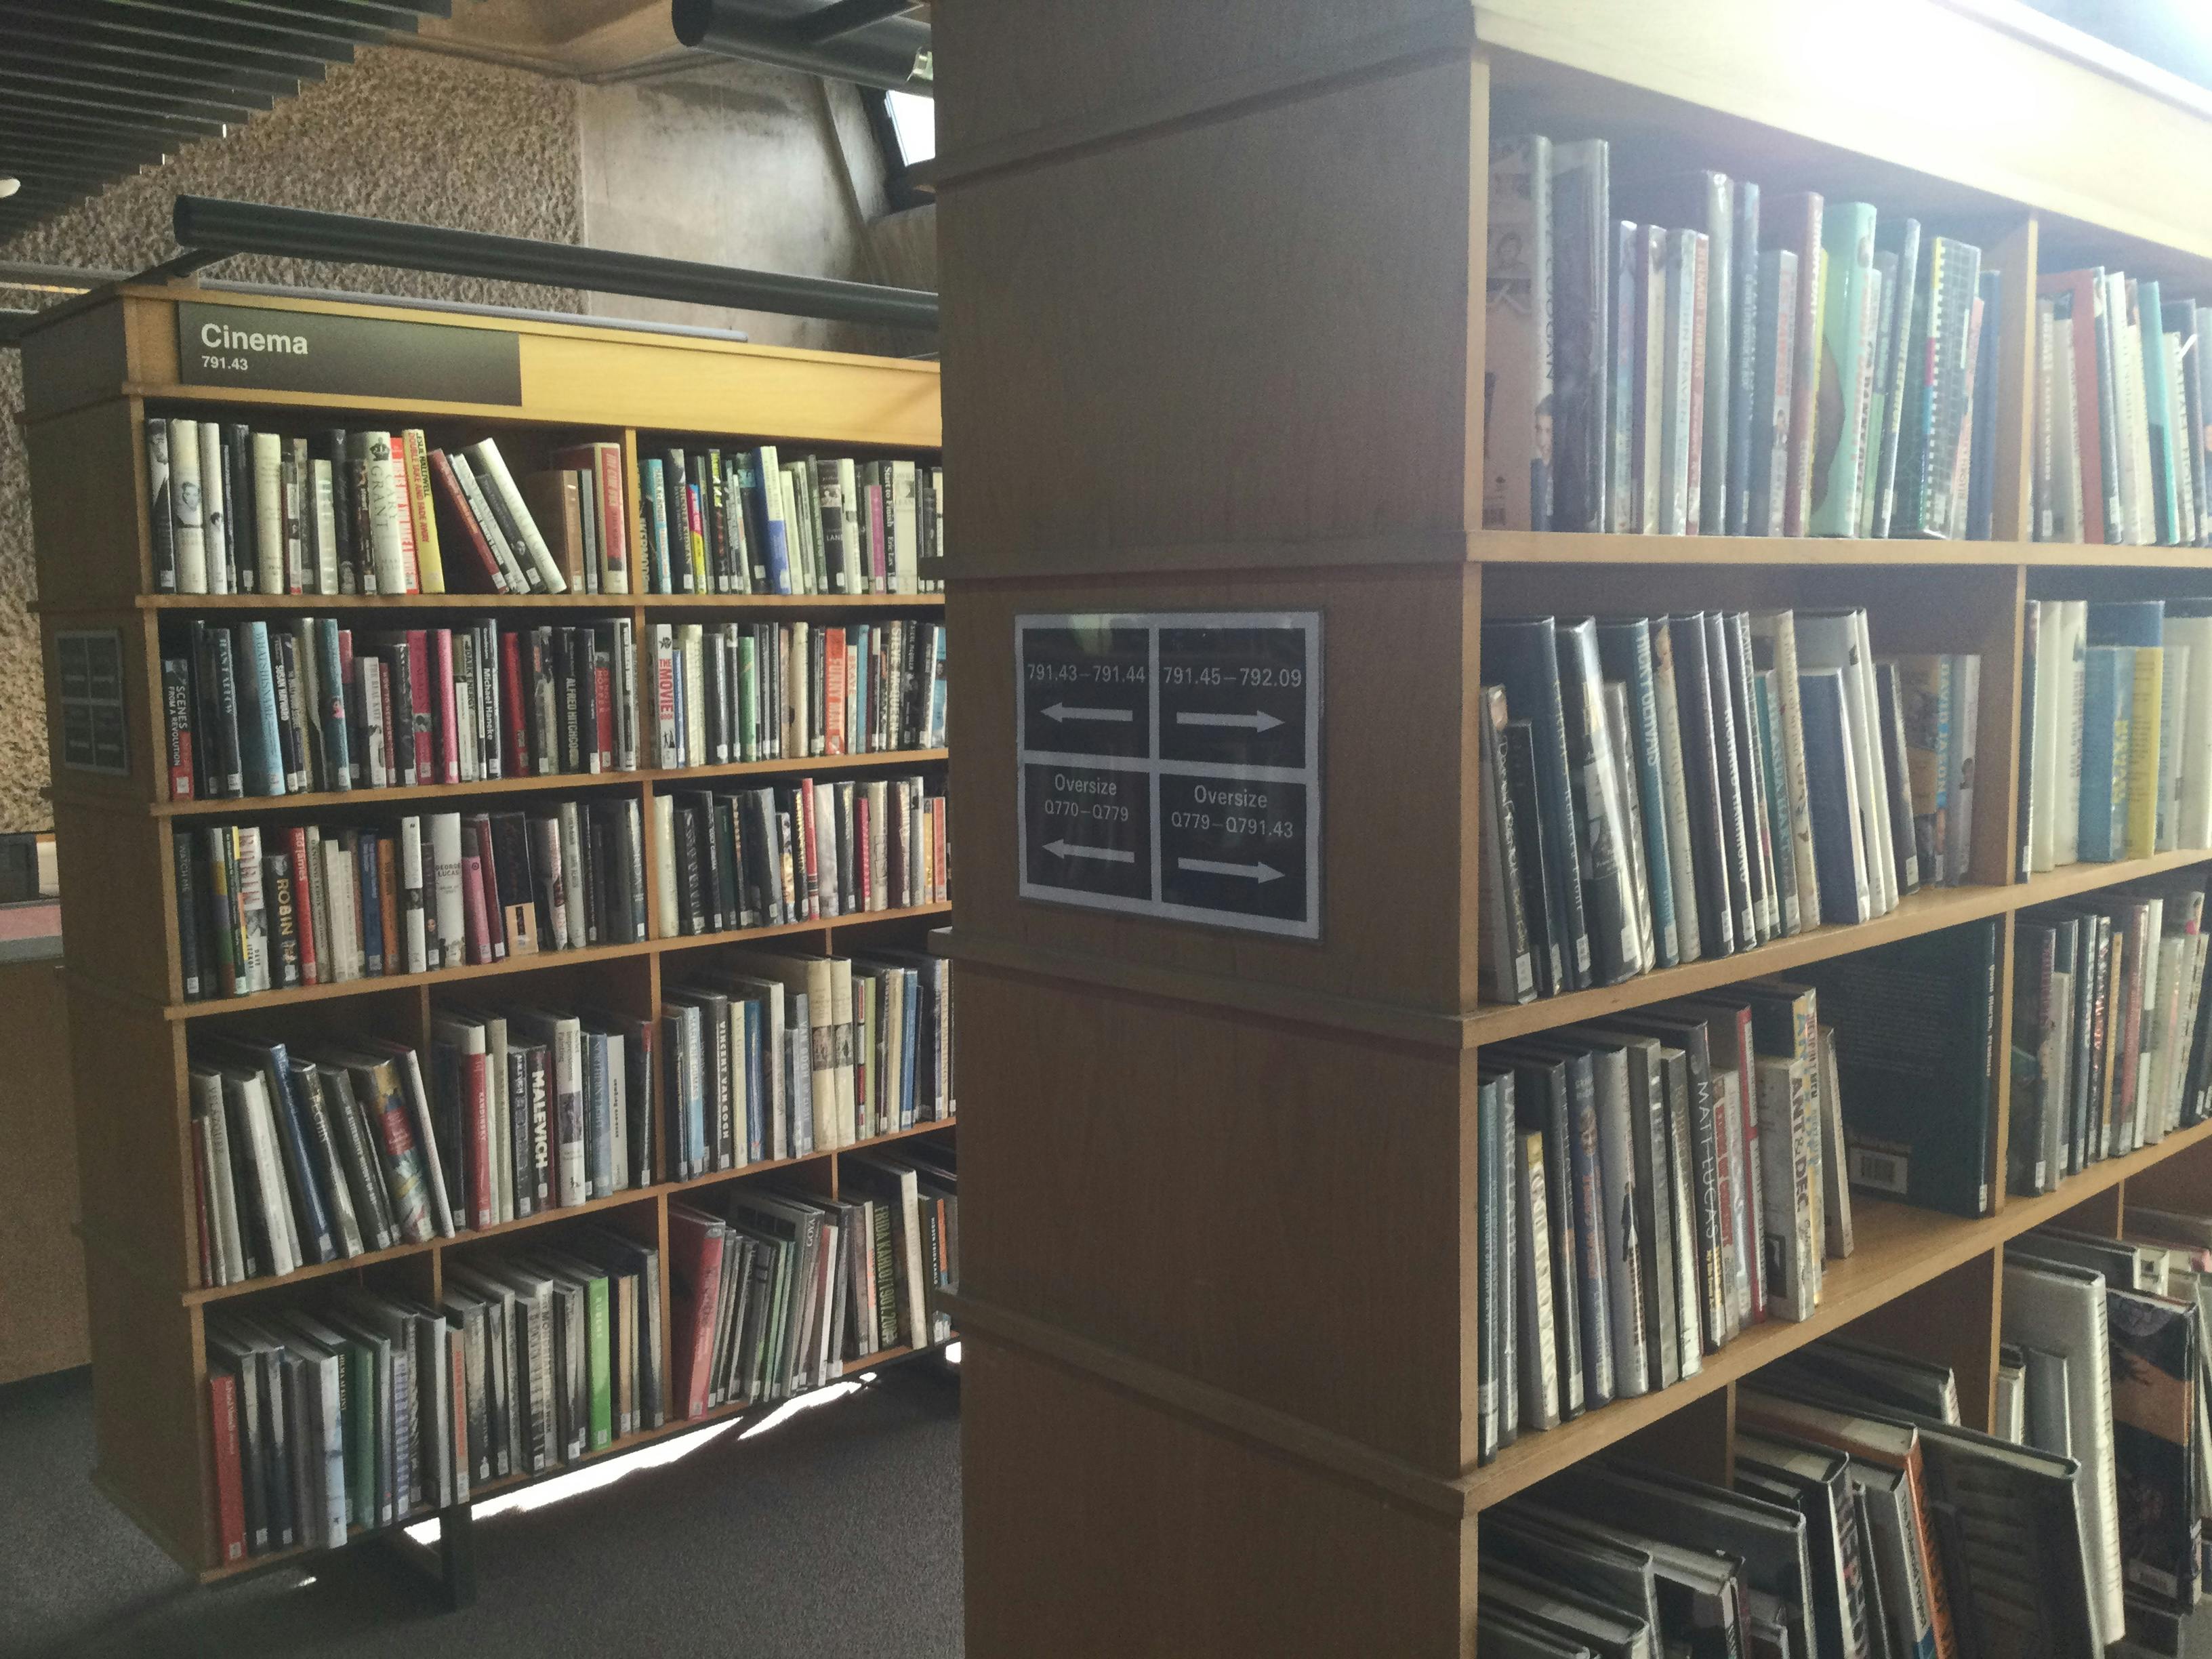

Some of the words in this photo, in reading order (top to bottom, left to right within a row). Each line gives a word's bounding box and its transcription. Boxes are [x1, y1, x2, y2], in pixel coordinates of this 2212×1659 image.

[201, 323, 308, 354] Cinema
[201, 355, 249, 371] 791.43
[415, 485, 424, 500] AND
[884, 466, 892, 487] Start
[370, 466, 389, 531] GRANT
[385, 474, 398, 520] CARY
[417, 502, 427, 520] FADE
[885, 489, 892, 499] to
[886, 500, 894, 527] Finish
[465, 650, 473, 674] DARK
[659, 658, 672, 668] THE
[891, 628, 901, 664] STEVE
[1635, 636, 1652, 688] RICKY
[274, 665, 286, 687] SUSAN
[466, 676, 474, 710] ENERGY
[483, 668, 491, 703] Michael
[658, 669, 674, 712] MOVIE
[829, 659, 842, 698] FUNNY
[1940, 662, 1950, 722] DAVID
[176, 686, 187, 729] SCENES
[276, 689, 289, 721] HAYWARD
[566, 678, 577, 710] ALFRED
[829, 702, 841, 730] MAN
[1640, 693, 1660, 766] GERVAIS
[171, 717, 180, 766] REVOLUTION
[1938, 731, 1949, 792] JASON
[1054, 773, 1117, 796] Oversize
[1194, 785, 1268, 808] Oversize
[179, 845, 189, 877] WATCH
[434, 862, 462, 871] GEORGE
[182, 879, 189, 893] ME
[276, 878, 293, 936] ROBIN
[799, 1021, 808, 1042] VAN
[565, 1031, 573, 1082] Impressionist
[800, 1047, 809, 1078] GOGH
[691, 1064, 699, 1099] DUMAS
[478, 1092, 487, 1141] KANDINSKY
[531, 1070, 548, 1168] MALEVICH
[721, 1105, 729, 1139] GOGH
[1696, 1081, 1714, 1143] MATT
[1791, 1077, 1805, 1134] ANT
[1702, 1158, 1719, 1239] LUCAS
[1794, 1156, 1809, 1212] DEC
[806, 1218, 817, 1247] GOYA
[1901, 1492, 1910, 1521] The
[1905, 1524, 1920, 1579] Polaroid
[1912, 1582, 1927, 1629] Project
